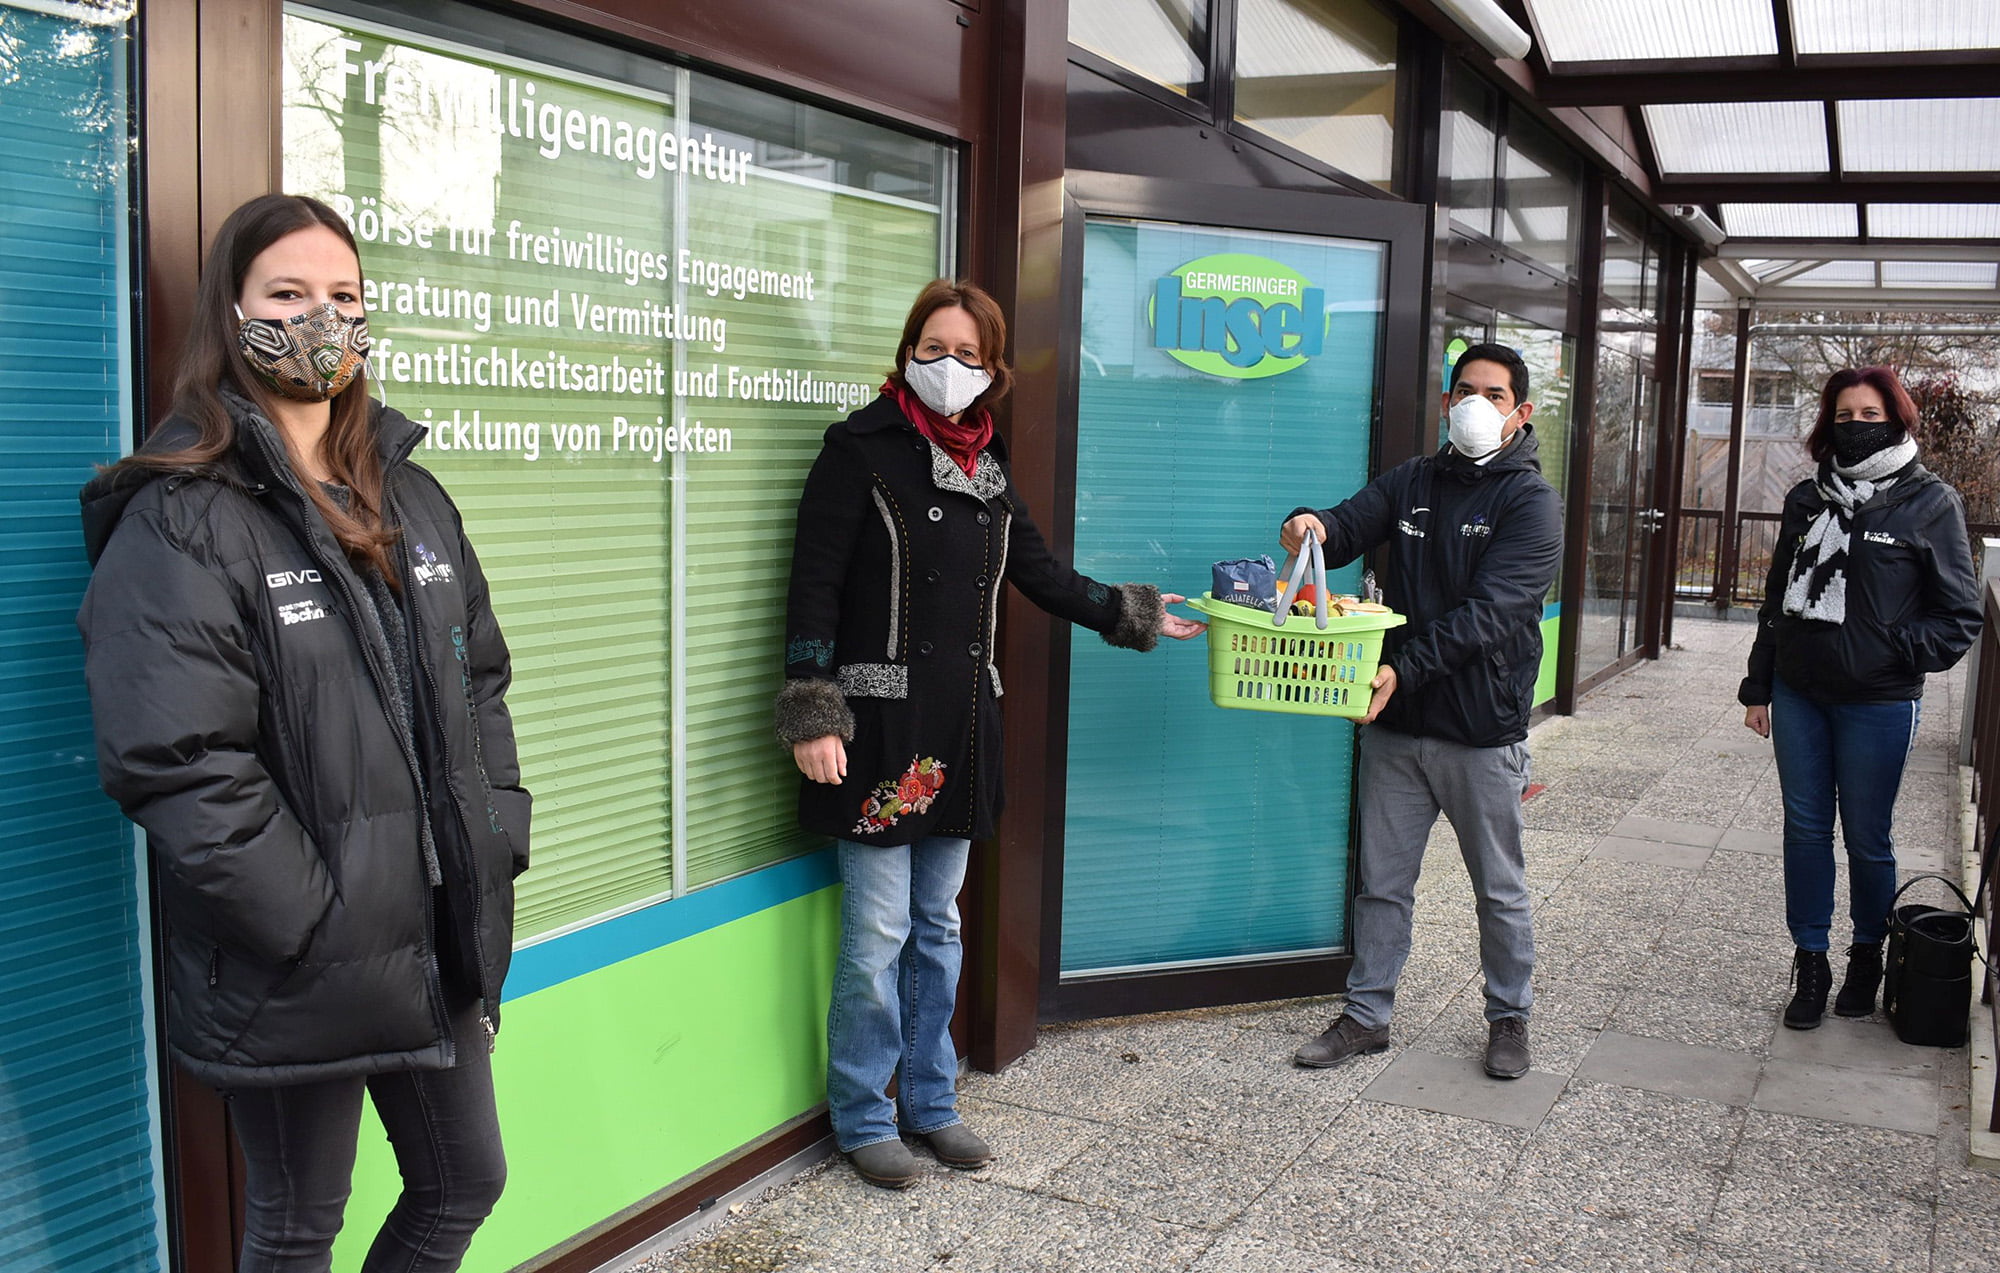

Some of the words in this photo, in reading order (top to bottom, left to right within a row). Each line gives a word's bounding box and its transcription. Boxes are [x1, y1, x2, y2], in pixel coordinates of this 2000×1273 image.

[506, 219, 668, 286] freiwilliges
[677, 249, 815, 301] Engagement
[1186, 271, 1298, 296] GERMERINGER
[363, 277, 492, 332] eratung
[504, 288, 560, 328] und
[570, 292, 727, 352] Vermittlung
[1155, 276, 1325, 368] Insel
[366, 337, 665, 395] ffentlichkeitsarbeit
[674, 363, 718, 398] und
[727, 365, 871, 413] Fortbildungen
[416, 408, 540, 462] icklung
[550, 422, 601, 452] von
[612, 415, 732, 462] Projekten
